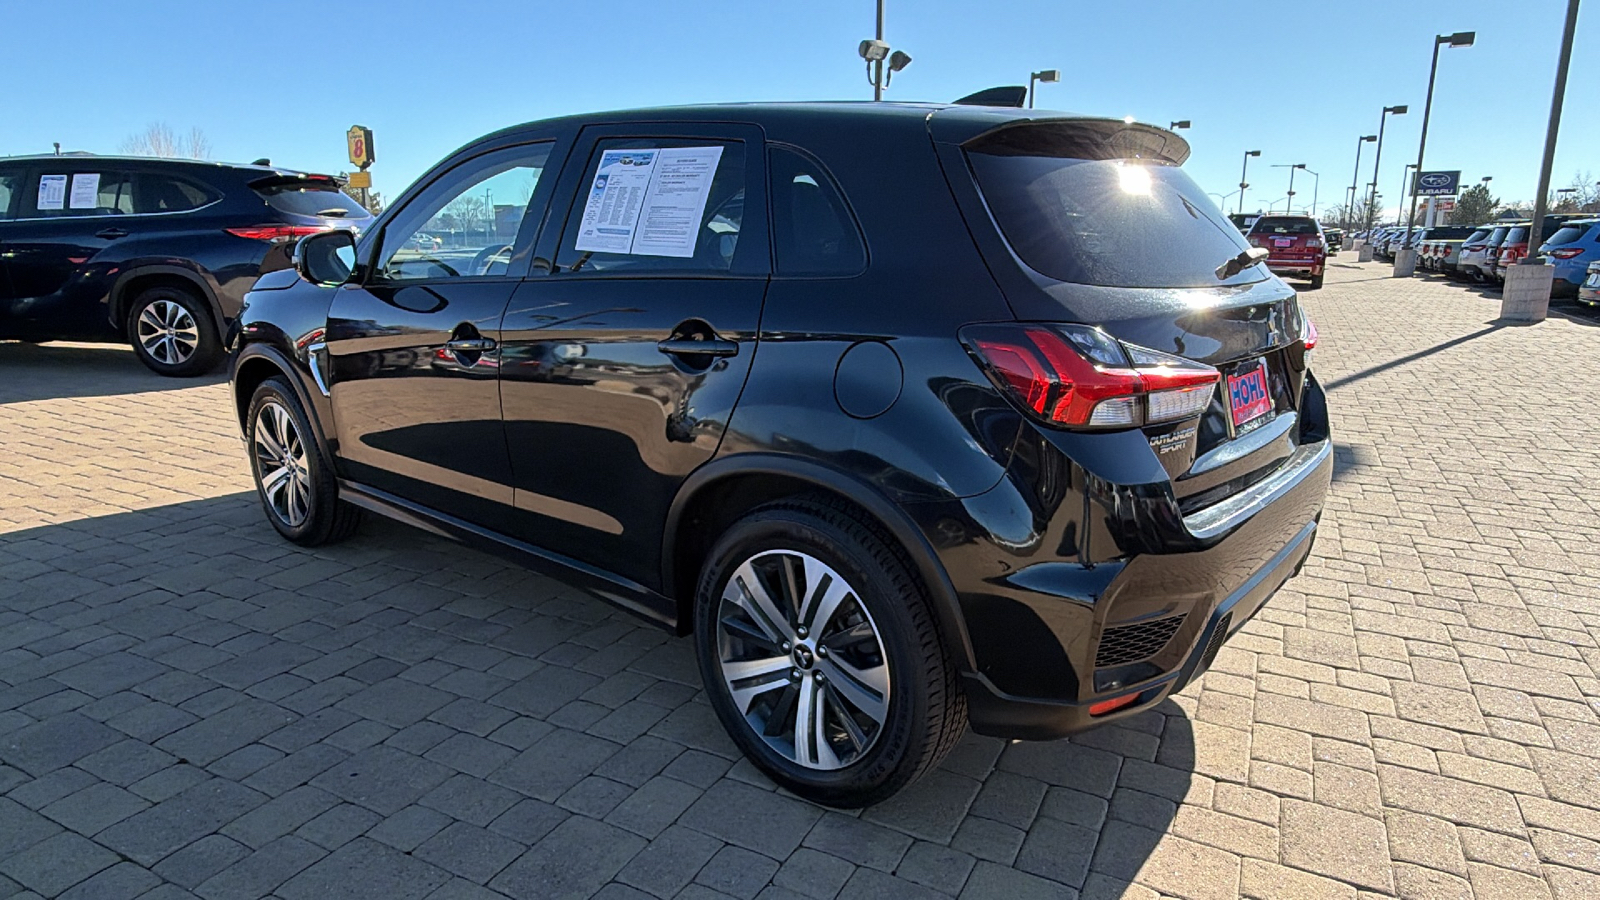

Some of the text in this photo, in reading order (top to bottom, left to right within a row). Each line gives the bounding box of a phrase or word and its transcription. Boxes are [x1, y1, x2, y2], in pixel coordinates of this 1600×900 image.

[1230, 373, 1265, 409] HOHL
[1150, 427, 1195, 446] OUTLANDER
[1160, 440, 1187, 454] SPORT
